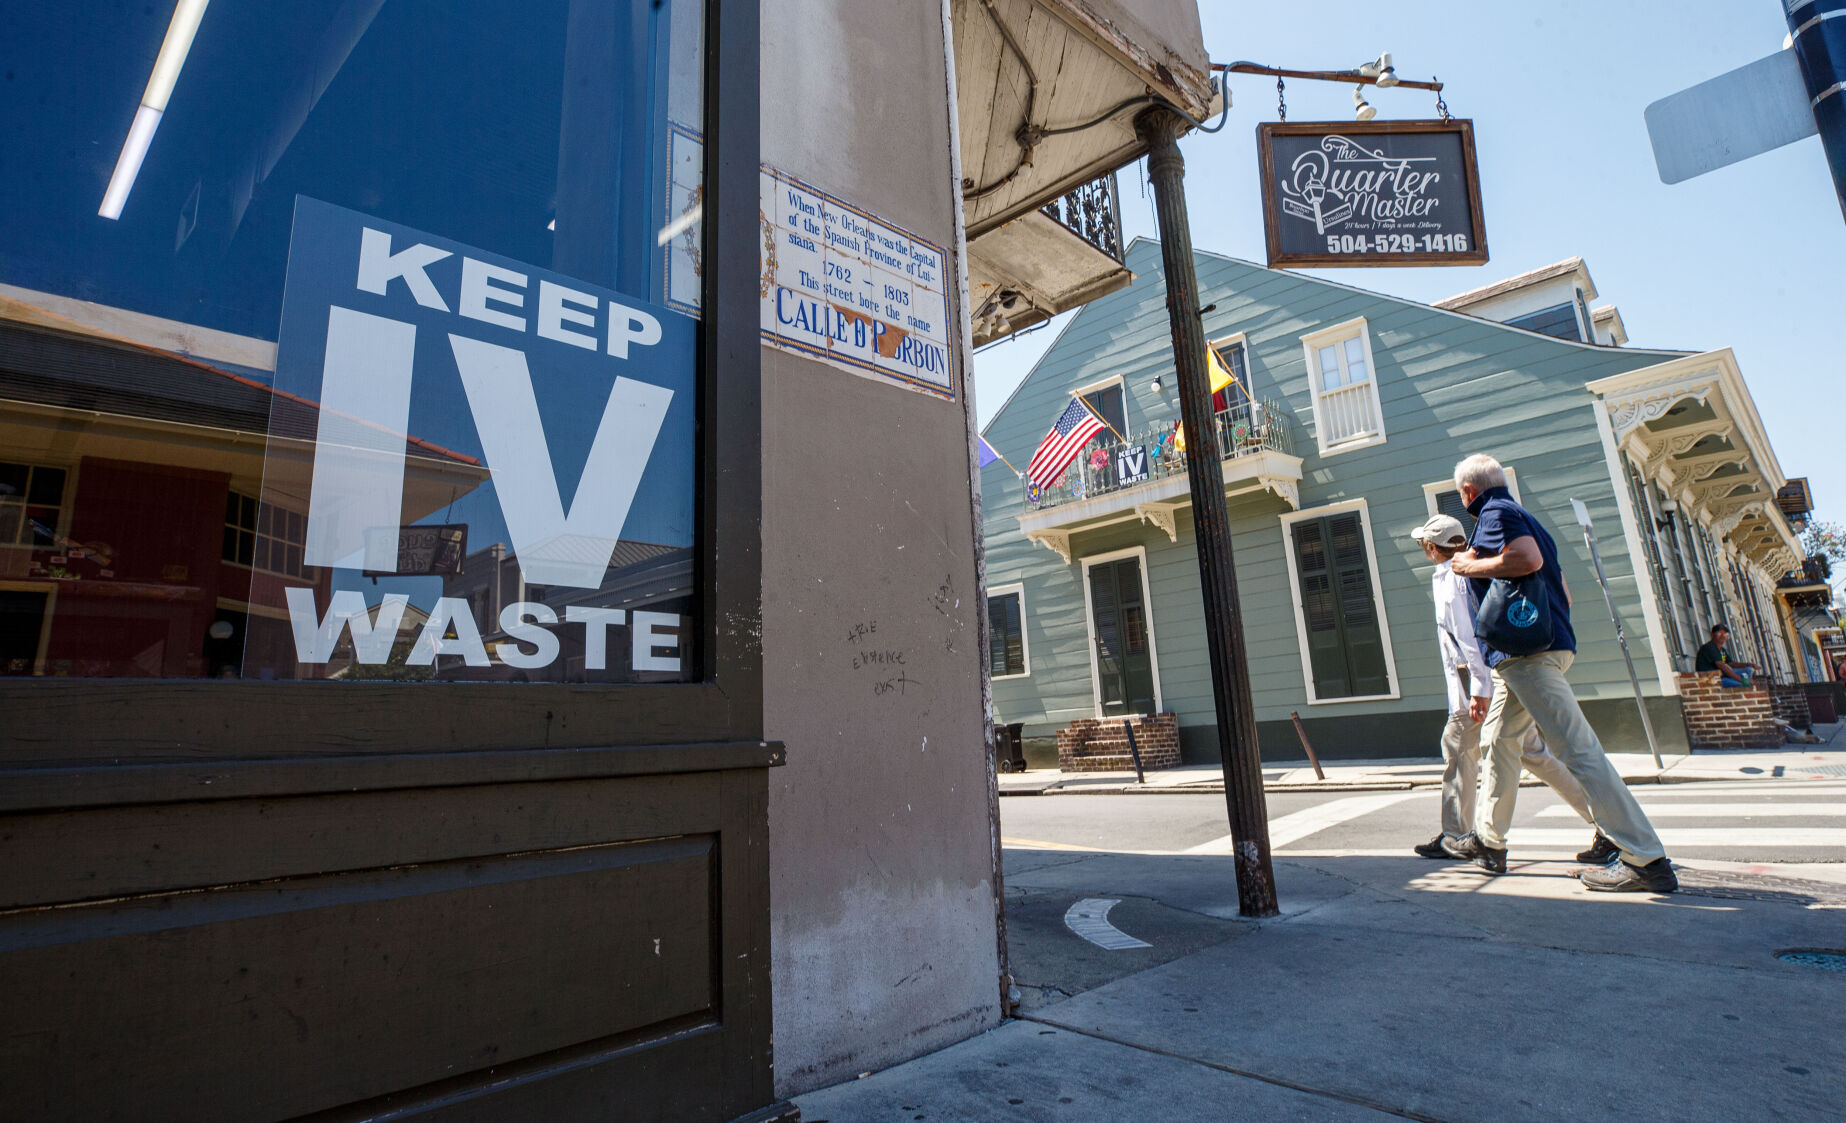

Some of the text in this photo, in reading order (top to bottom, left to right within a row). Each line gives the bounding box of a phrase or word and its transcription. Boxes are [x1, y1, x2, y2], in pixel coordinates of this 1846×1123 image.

[1281, 150, 1440, 200] Quarter
[1335, 144, 1358, 160] The
[788, 190, 936, 269] When New Orleans was the Capital
[1322, 209, 1351, 224] Ursulines
[1345, 190, 1439, 223] Master
[788, 232, 818, 254] siana.
[788, 213, 936, 282] of the Spanish Province of Lui-
[1327, 233, 1468, 253] 504-529-1416
[356, 226, 663, 361] KEEP
[799, 269, 931, 333] This street bore the name
[822, 260, 853, 284] 1762
[884, 283, 910, 306] 1803
[776, 286, 848, 344] CALLE
[303, 304, 676, 590] IV
[1117, 452, 1144, 479] IV
[1118, 446, 1142, 459] KEEP
[1119, 472, 1148, 486] WASTE
[284, 585, 682, 673] WASTE
